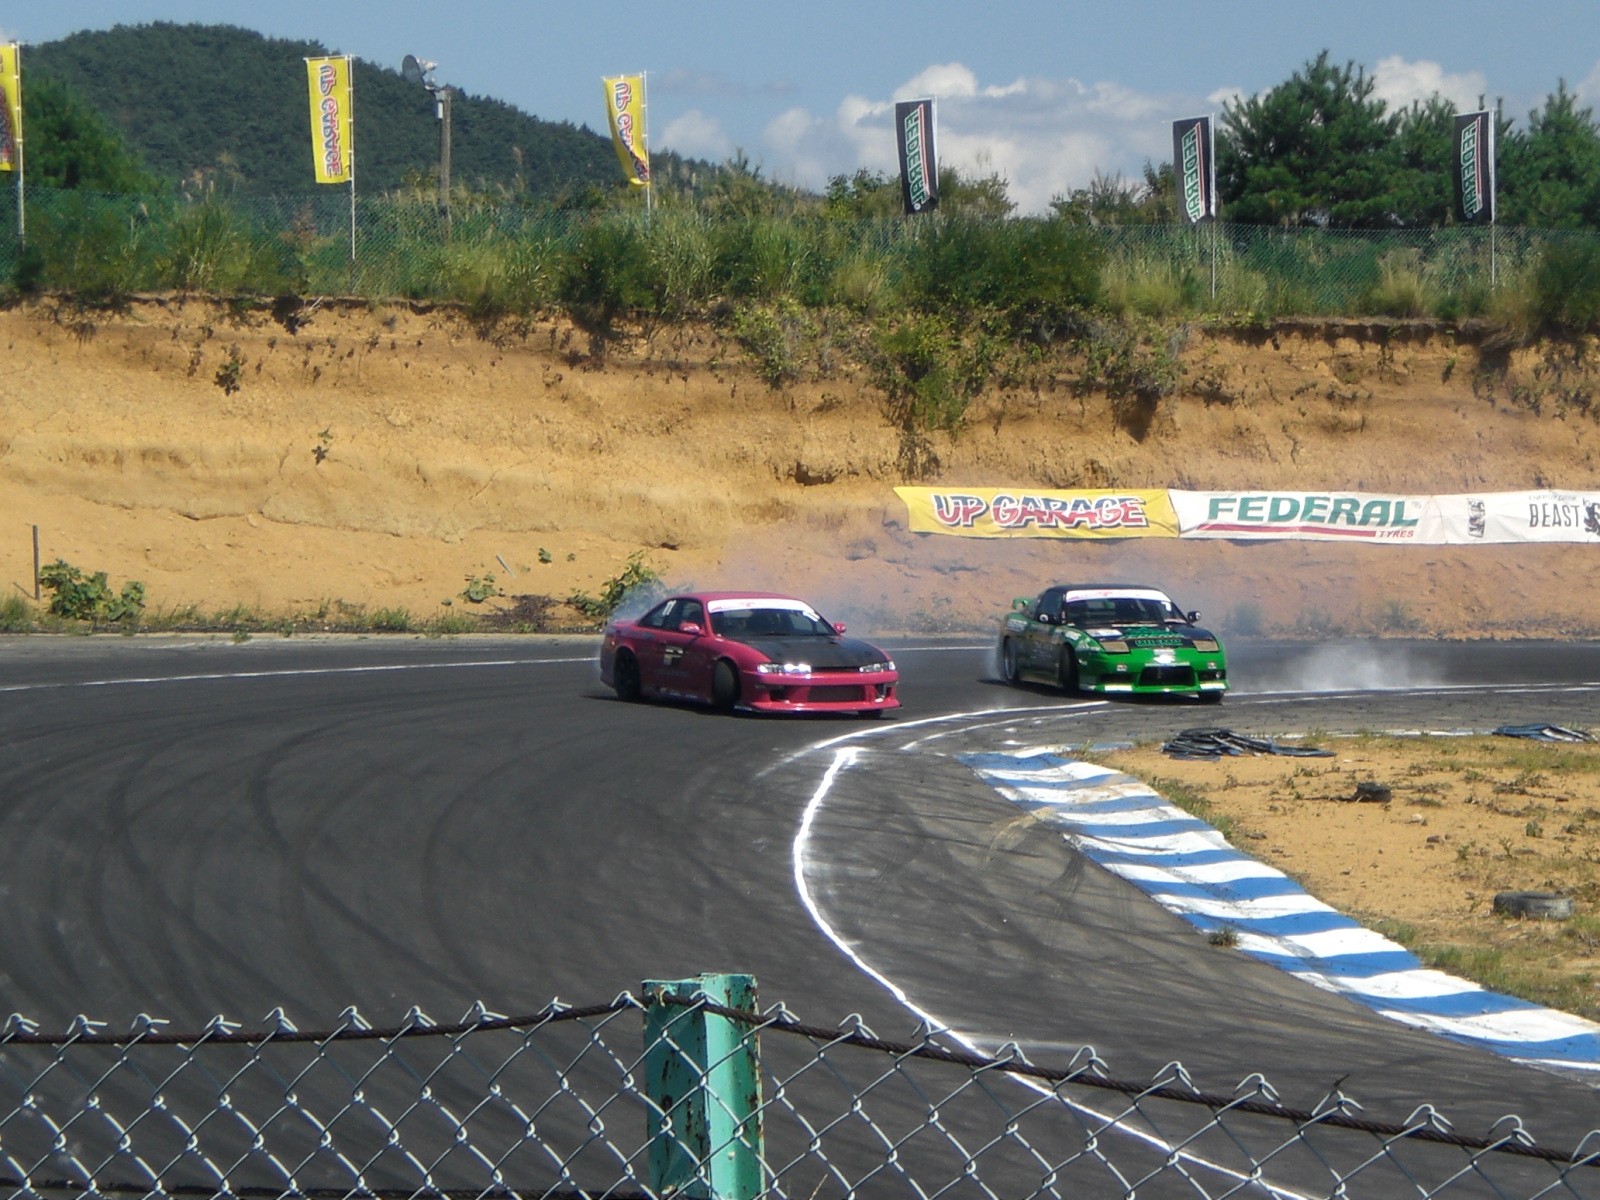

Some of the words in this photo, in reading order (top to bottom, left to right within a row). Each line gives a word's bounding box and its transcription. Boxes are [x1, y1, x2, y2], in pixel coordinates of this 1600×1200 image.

[319, 64, 338, 96] UP
[614, 81, 632, 111] UP
[321, 97, 343, 178] GARAGE
[904, 109, 927, 205] FEDERAL
[1181, 127, 1201, 220] FEDERAL
[1461, 120, 1478, 214] FEDERAL
[933, 494, 988, 526] UP
[990, 494, 1149, 529] GARAGE
[1208, 495, 1419, 527] FEDERAL
[1529, 503, 1580, 528] BEAST
[1379, 529, 1414, 538] TYRES
